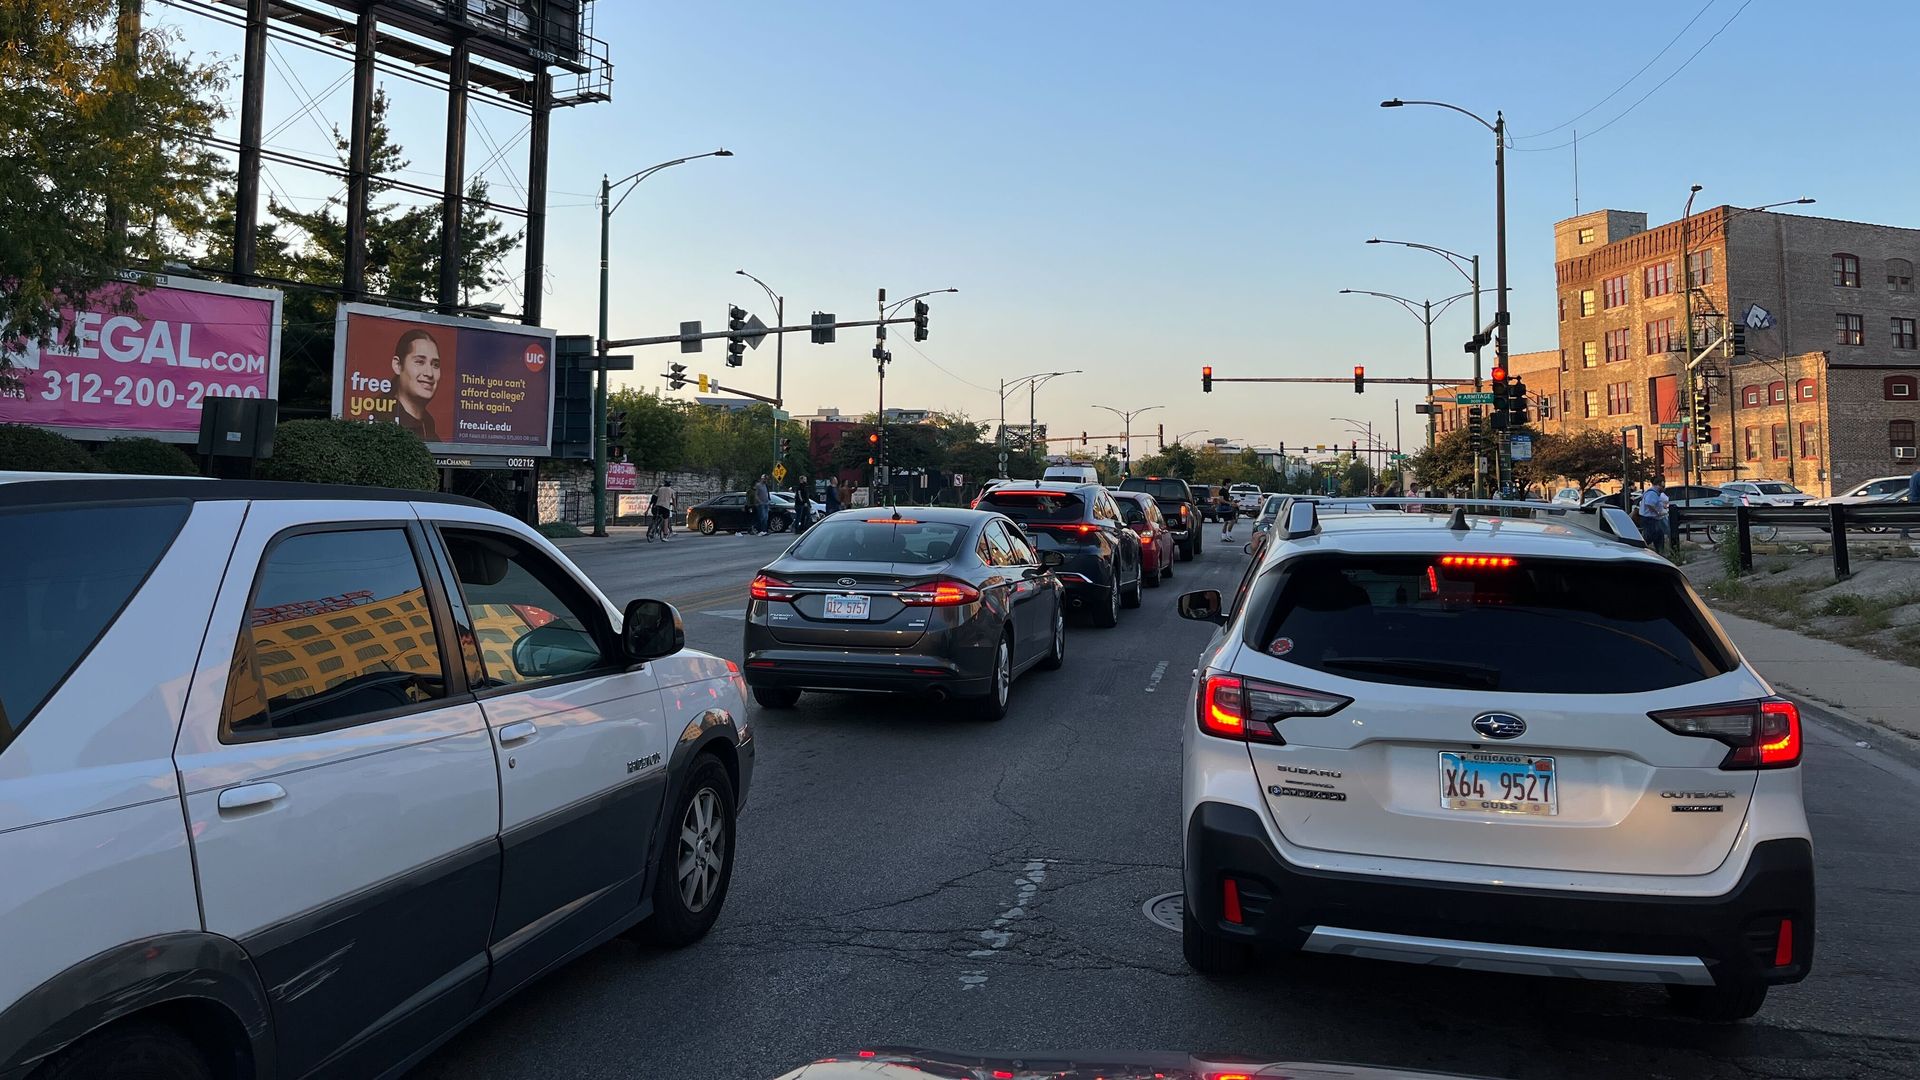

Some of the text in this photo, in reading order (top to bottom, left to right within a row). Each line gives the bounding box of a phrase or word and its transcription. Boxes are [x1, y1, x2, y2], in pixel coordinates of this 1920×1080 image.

[526, 352, 544, 364] UIC
[351, 371, 392, 393] free
[461, 374, 526, 389] Think you can't
[0, 387, 25, 399] ERS
[461, 387, 525, 402] afford college?
[350, 396, 397, 416] your
[460, 400, 512, 414] Think again.
[460, 419, 512, 432] free.uic.edu
[508, 458, 535, 468] 002712
[846, 601, 867, 614] 5757
[1473, 754, 1521, 763] CHICAGO
[1277, 764, 1342, 779] SUBARU
[1446, 769, 1551, 802] X64 9527
[1661, 790, 1736, 799] OUTBACK
[1480, 801, 1518, 811] CUBS
